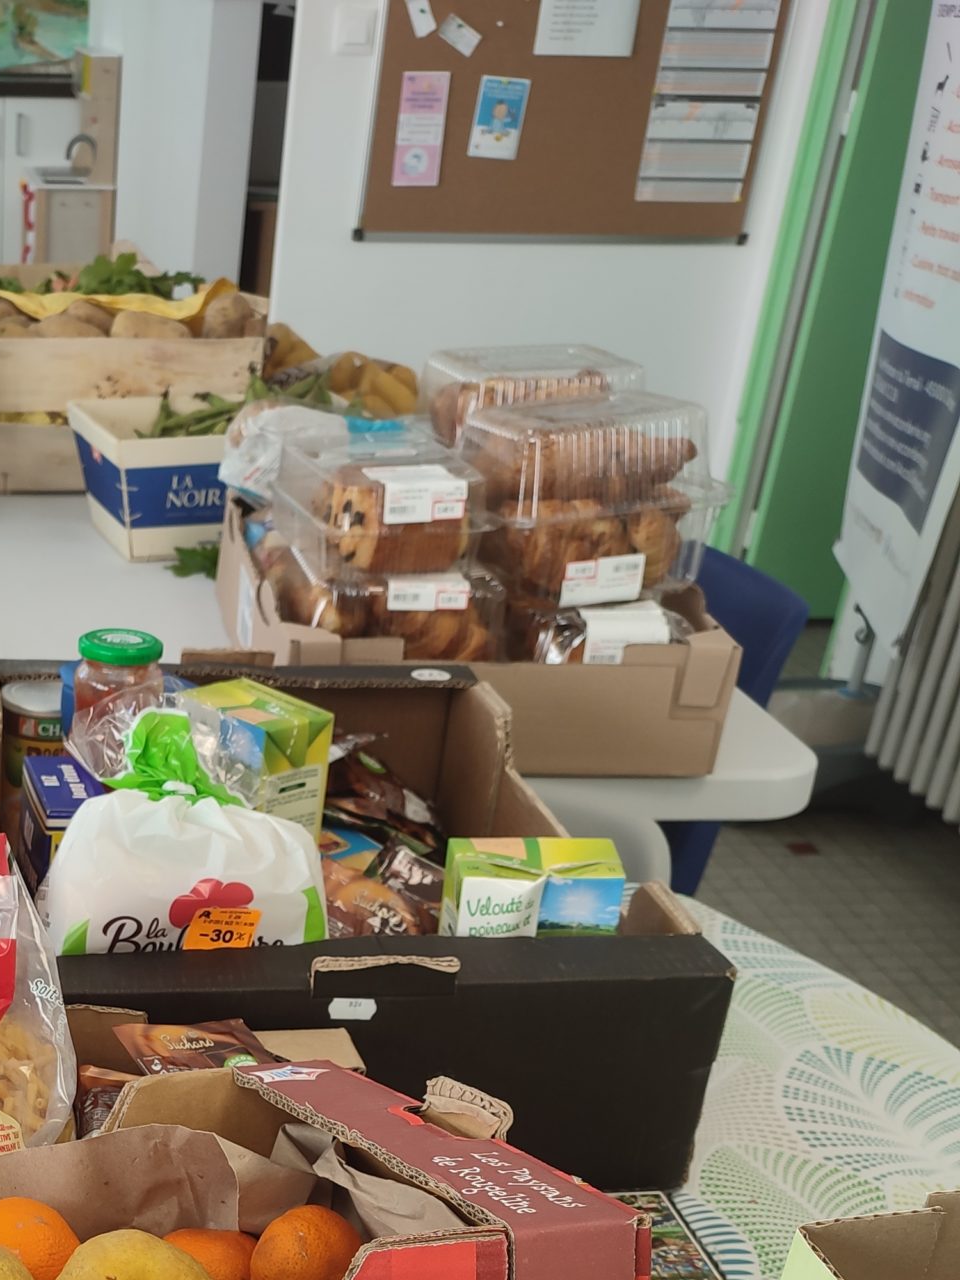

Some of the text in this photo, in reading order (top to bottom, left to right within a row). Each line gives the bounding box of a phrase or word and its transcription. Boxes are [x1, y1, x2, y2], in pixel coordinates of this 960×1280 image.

[466, 895, 523, 917] Velouté
[146, 916, 169, 939] la
[431, 1155, 463, 1167] de
[470, 1151, 587, 1208] Les Paysans
